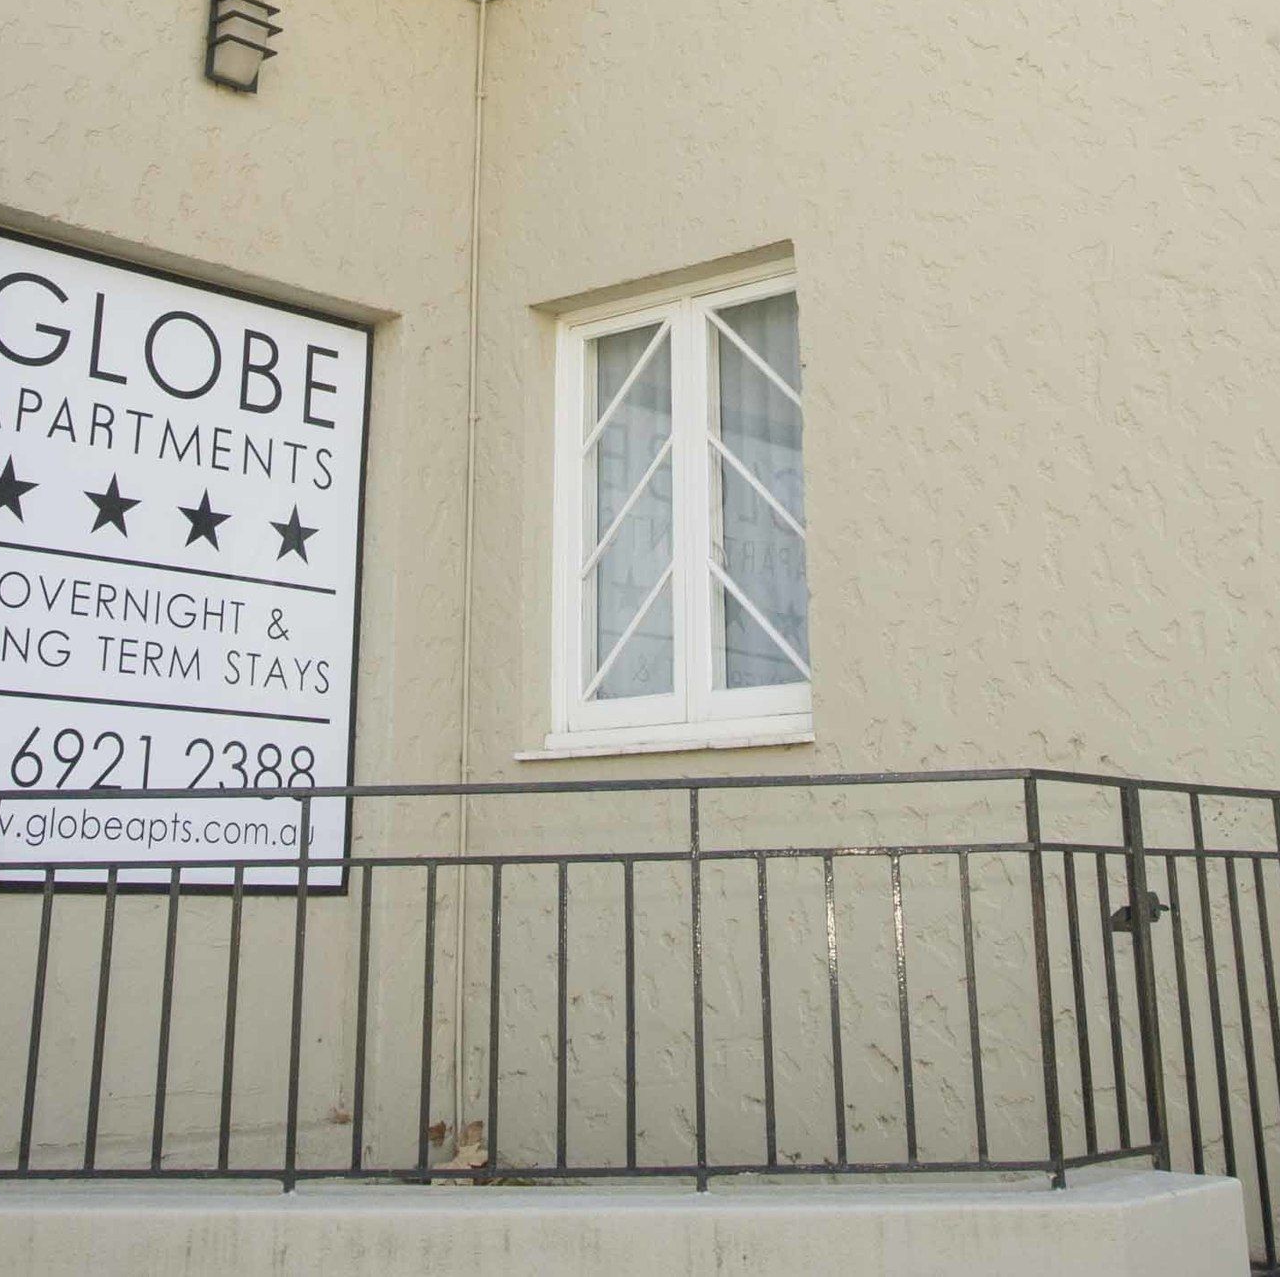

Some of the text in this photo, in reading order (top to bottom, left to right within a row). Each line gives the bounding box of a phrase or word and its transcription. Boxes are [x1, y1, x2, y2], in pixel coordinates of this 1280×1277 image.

[266, 607, 290, 640] &
[97, 635, 201, 680] TERM
[224, 649, 330, 694] STAYS
[10, 725, 153, 790] 6921
[184, 737, 317, 800] 2388
